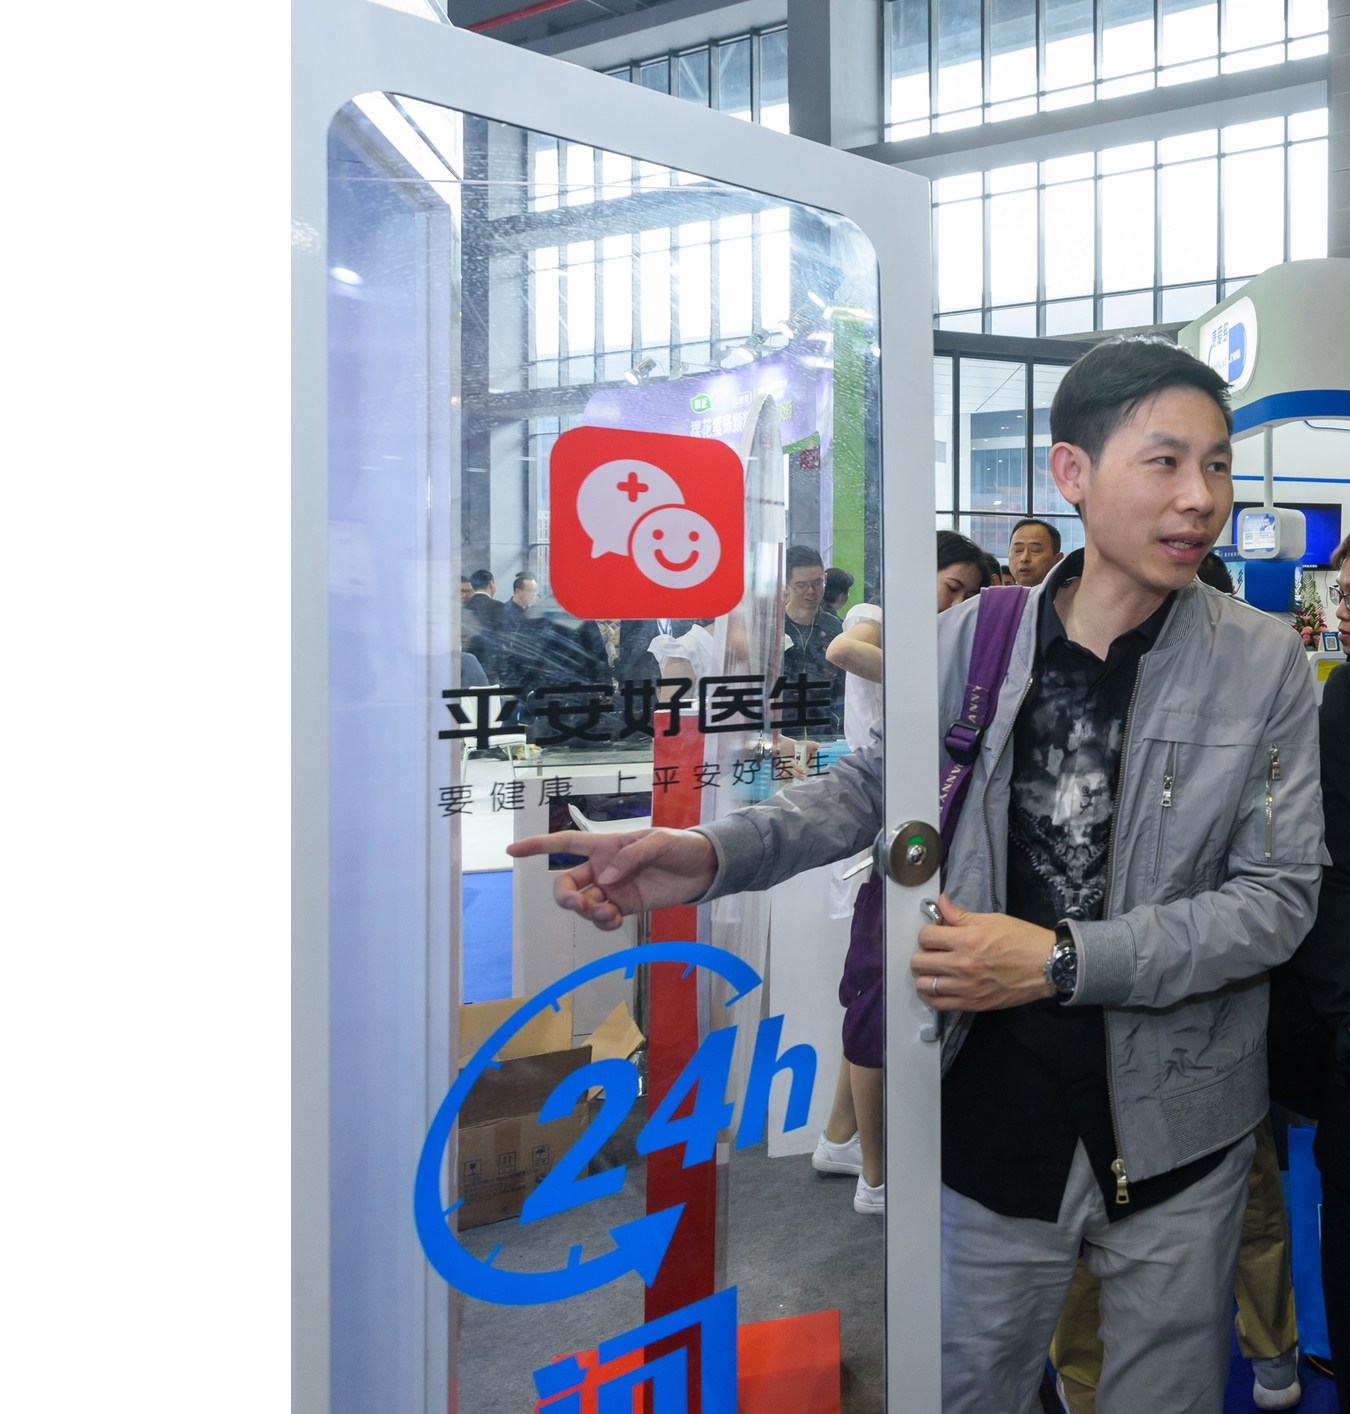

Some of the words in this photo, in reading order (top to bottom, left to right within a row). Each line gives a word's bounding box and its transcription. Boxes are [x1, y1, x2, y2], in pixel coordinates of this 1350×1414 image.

[438, 673, 832, 750] 平安好医生
[437, 775, 573, 818] 要健康
[612, 753, 830, 798] 上平安好医生
[519, 1014, 818, 1226] 24h
